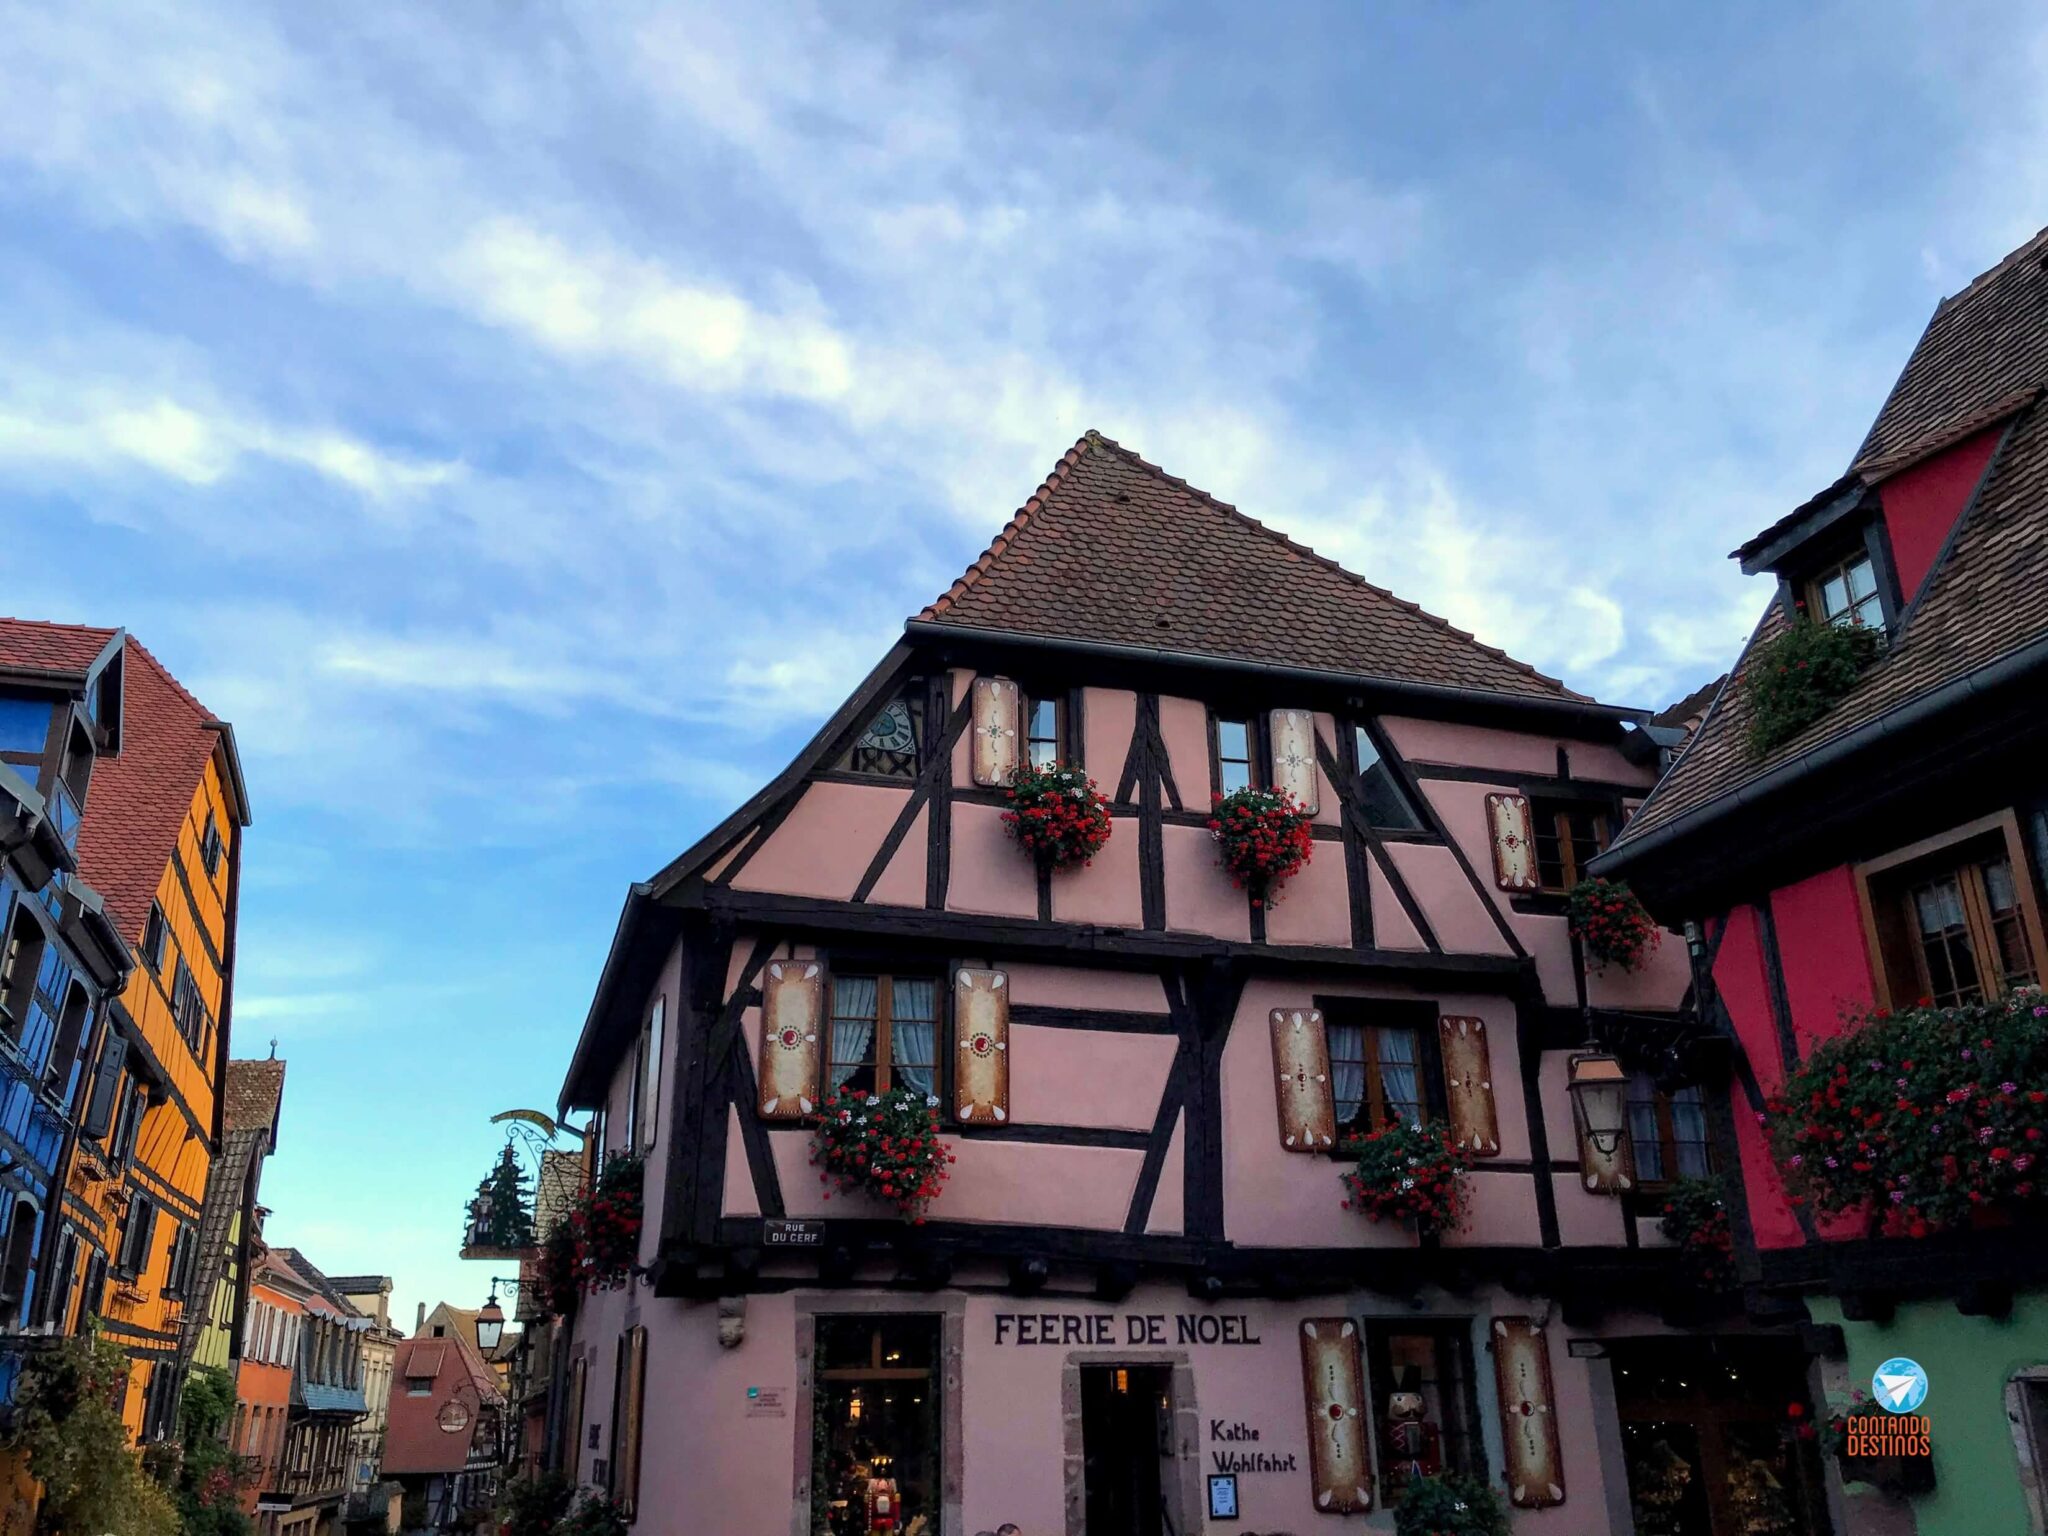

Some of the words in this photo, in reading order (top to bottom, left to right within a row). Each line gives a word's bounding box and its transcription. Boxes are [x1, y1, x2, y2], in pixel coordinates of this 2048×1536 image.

[772, 1232, 787, 1242] DU
[789, 1233, 818, 1243] CERF
[785, 1224, 805, 1232] RUE
[994, 1314, 1116, 1345] FEERIE
[1125, 1314, 1167, 1345] DE
[1175, 1314, 1261, 1345] NOEL
[1210, 1419, 1260, 1441] Kathe
[1212, 1450, 1297, 1473] Wohlfahrt
